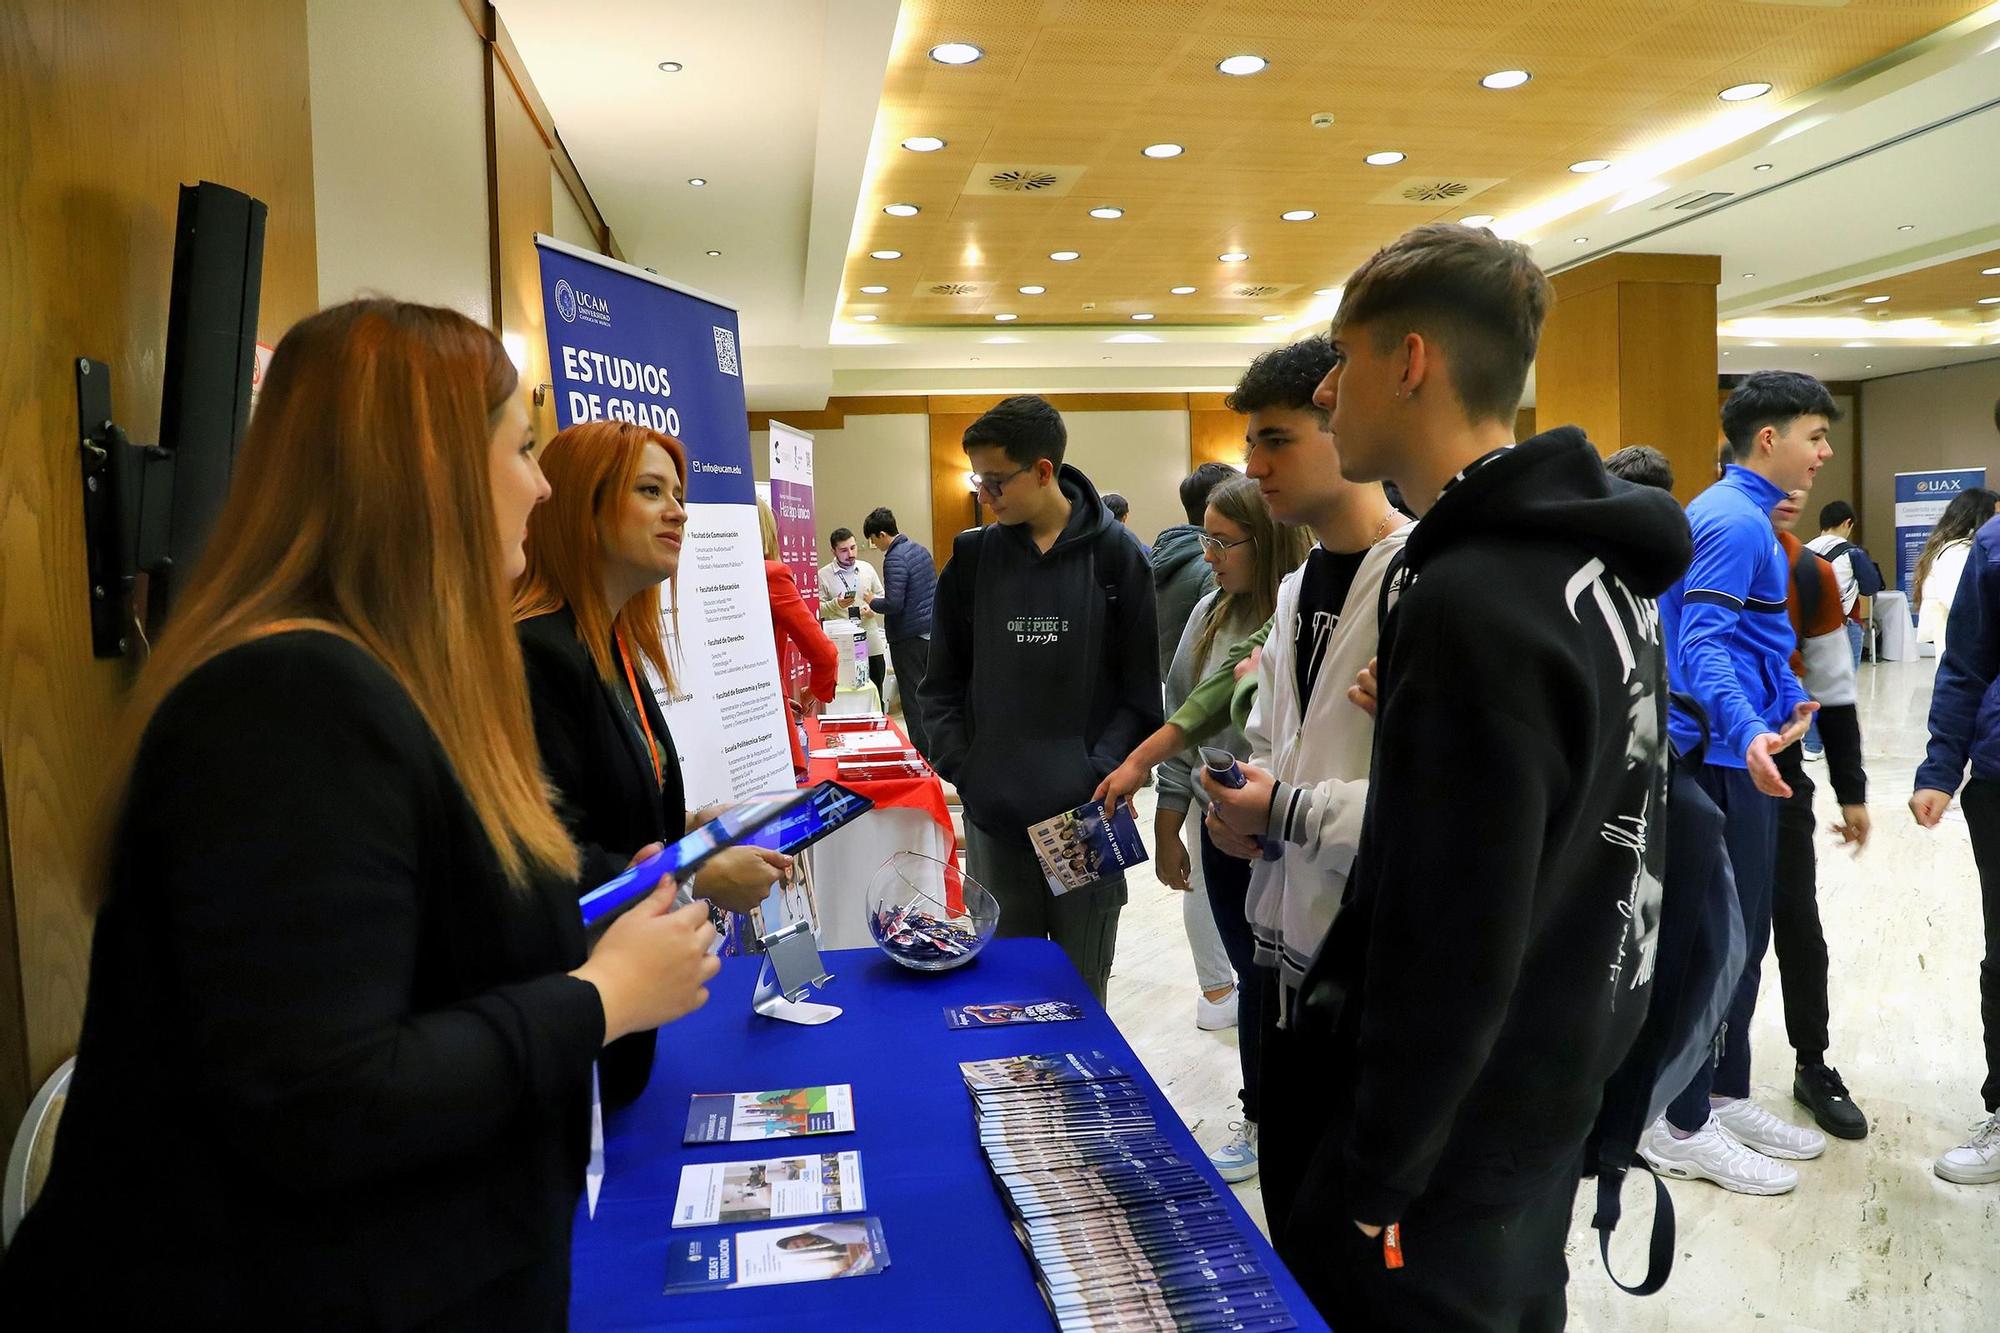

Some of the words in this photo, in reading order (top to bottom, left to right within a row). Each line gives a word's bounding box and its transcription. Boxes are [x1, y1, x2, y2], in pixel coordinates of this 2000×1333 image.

[575, 290, 610, 314] UCAM
[562, 346, 671, 397] ESTUDIOS
[569, 391, 603, 425] DE
[607, 398, 680, 437] GRADO
[1929, 479, 1961, 491] UAX
[1032, 620, 1069, 632] PIECE
[727, 634, 745, 642] Derecho
[1107, 832, 1115, 842] TU
[1111, 841, 1126, 866] LIDERA
